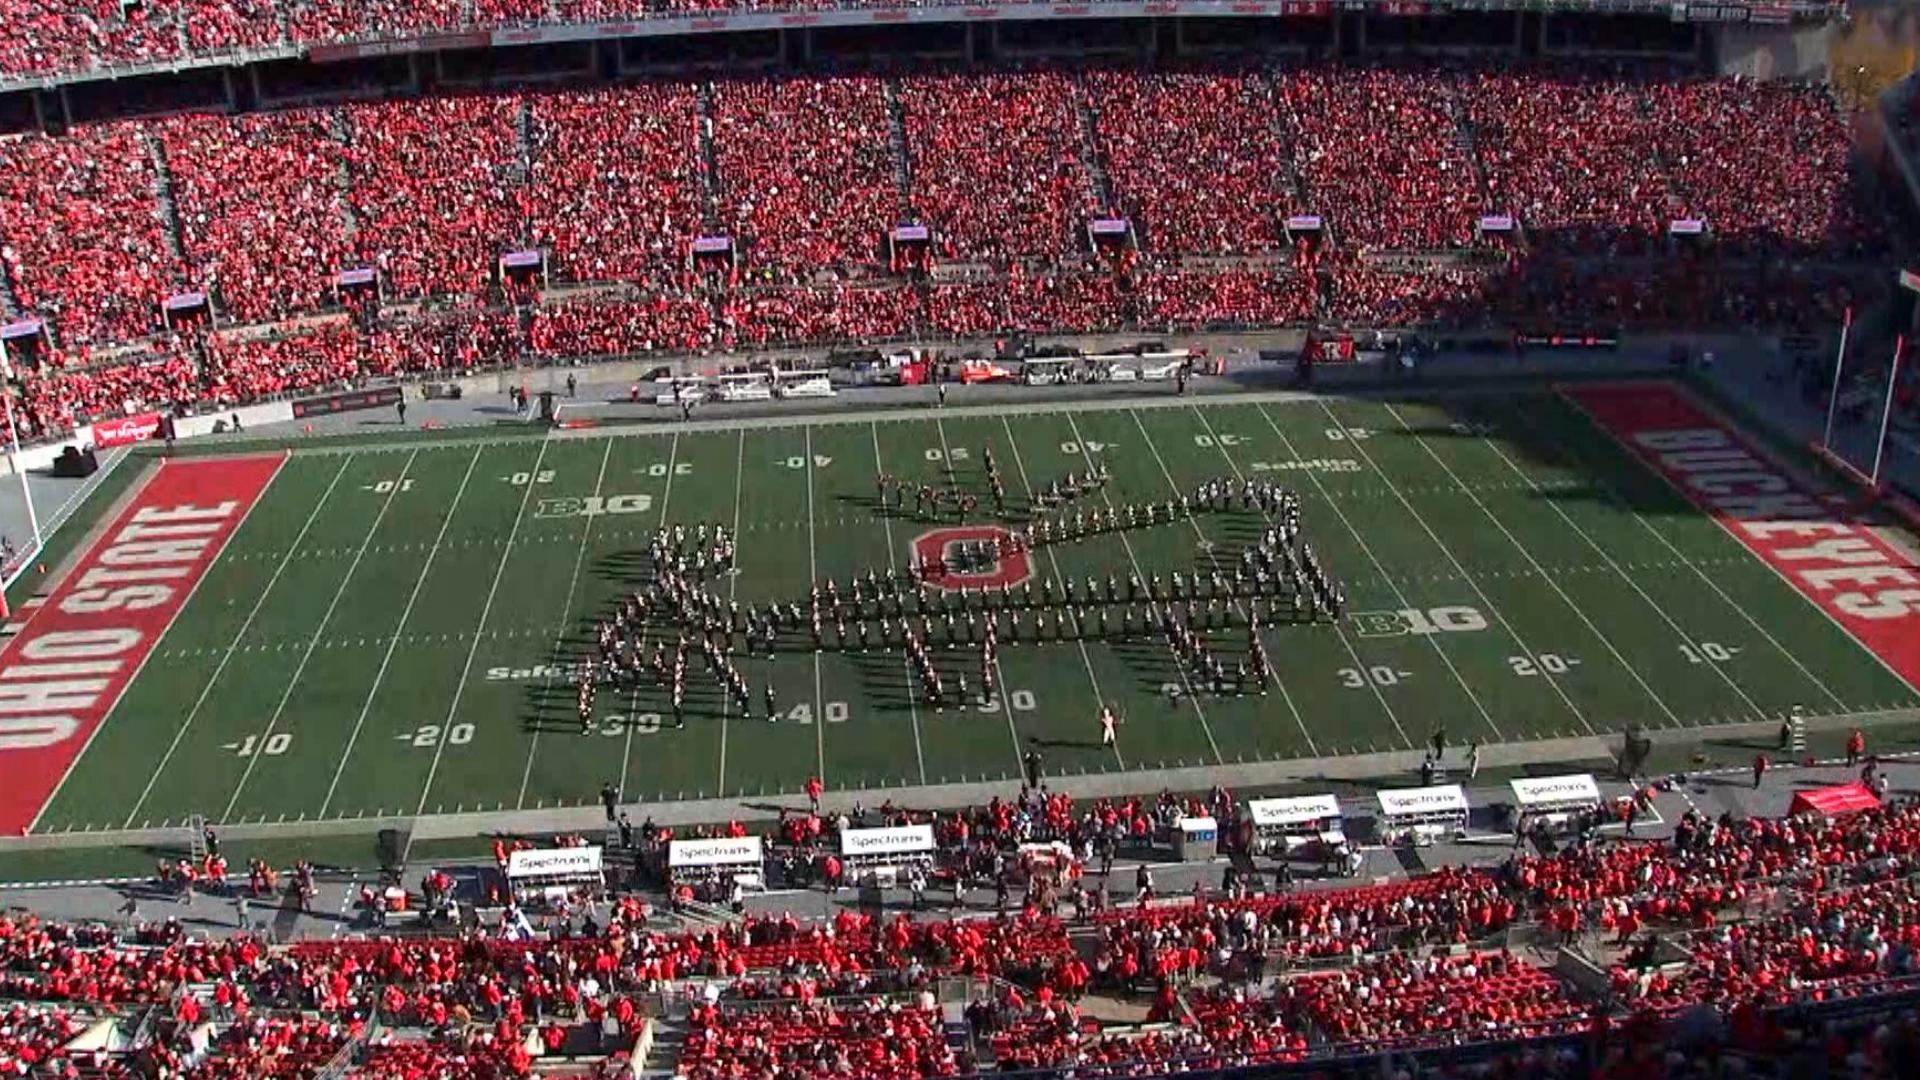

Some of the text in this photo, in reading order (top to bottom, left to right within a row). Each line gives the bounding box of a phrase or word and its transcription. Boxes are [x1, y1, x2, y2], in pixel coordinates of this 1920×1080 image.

[0, 500, 240, 750] OHIO STATE
[1678, 642, 1732, 663] 10
[1337, 664, 1399, 688] 30
[1509, 653, 1568, 676] 20
[786, 701, 849, 724] 40
[411, 722, 477, 748] 20
[600, 714, 663, 737] 30
[236, 732, 293, 757] 10
